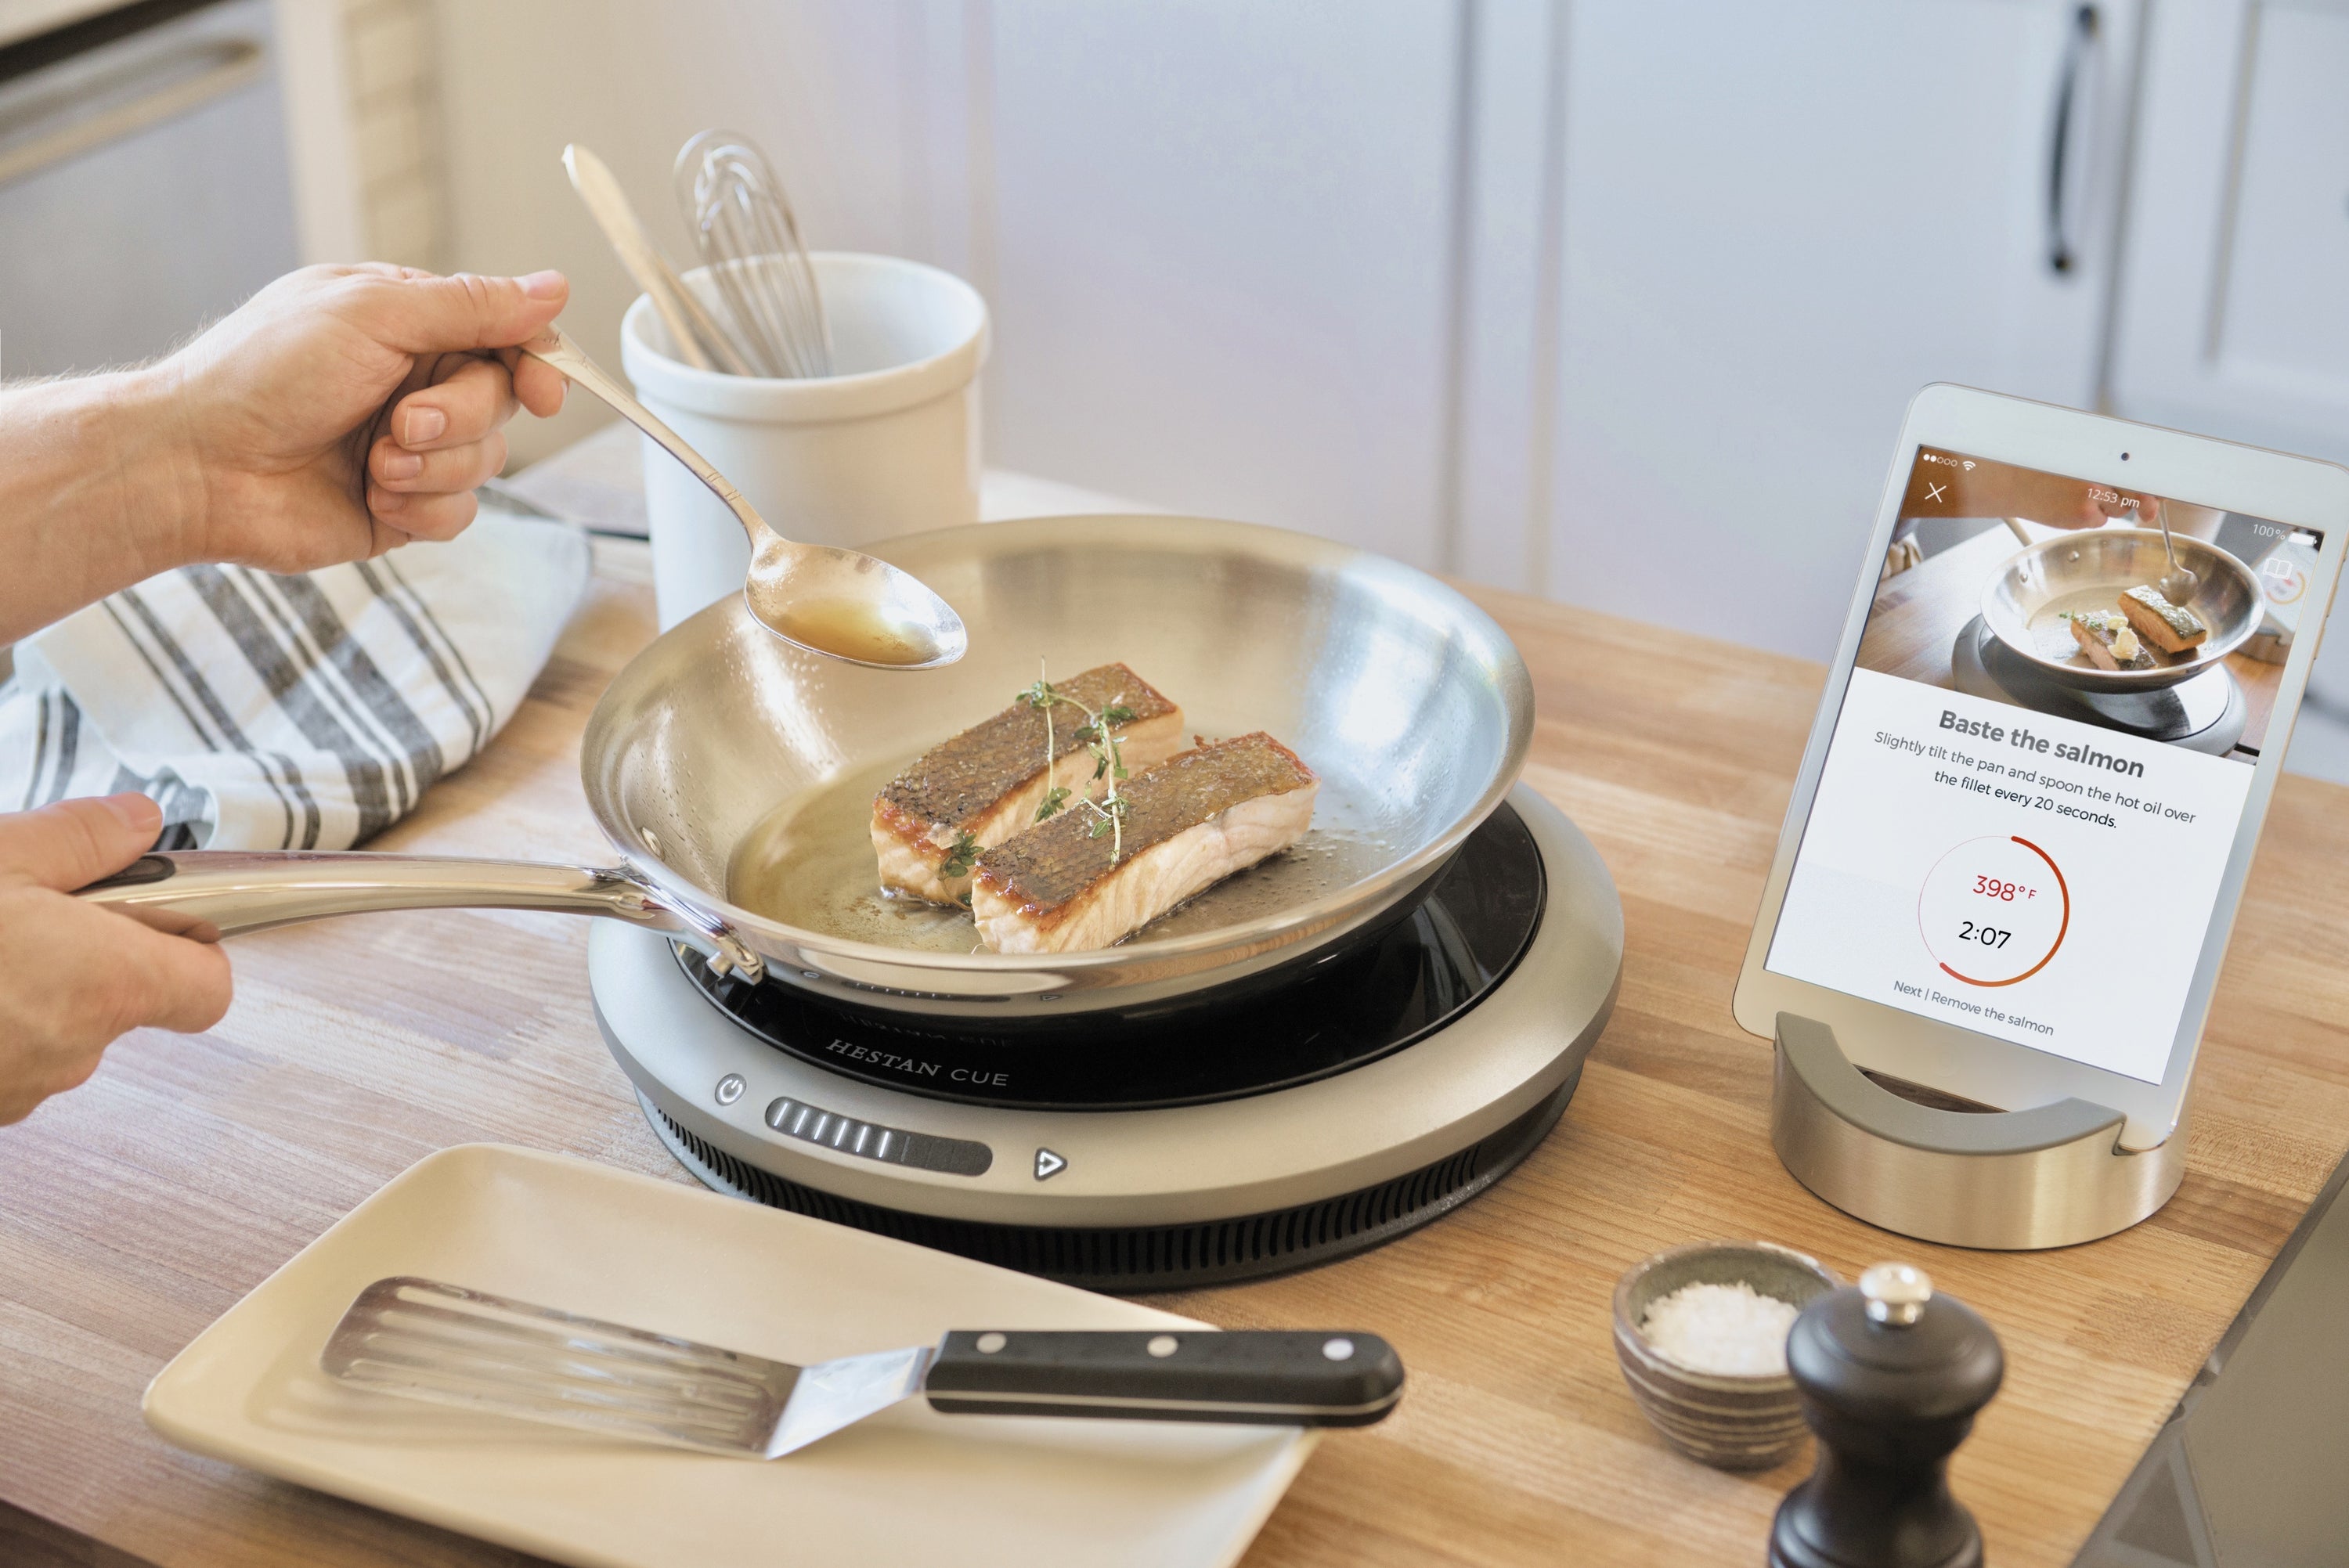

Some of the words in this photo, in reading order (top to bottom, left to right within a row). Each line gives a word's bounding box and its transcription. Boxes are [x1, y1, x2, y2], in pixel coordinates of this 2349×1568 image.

[2087, 487, 2118, 505] 12:53
[2120, 494, 2141, 510] pm
[2253, 523, 2286, 540] 100%
[1938, 709, 2005, 742] Baste
[2010, 729, 2050, 754] the
[2054, 742, 2145, 779] salmon
[1875, 731, 1925, 756] Slightly
[1928, 744, 1948, 760] tilt
[1950, 751, 1975, 767] the
[1976, 759, 2005, 775] pan
[2008, 767, 2037, 783] and
[2039, 776, 2084, 795] spoon
[2087, 785, 2112, 802] the
[2115, 793, 2140, 809] hot
[2142, 801, 2161, 815] oil
[2163, 809, 2196, 824] over
[1934, 770, 1958, 787] the
[1961, 777, 1992, 795] fillet
[1994, 787, 2033, 808] every
[2034, 796, 2054, 811] 20
[2056, 802, 2117, 829] seconds.
[1958, 921, 2012, 949] 2:07
[1893, 980, 1923, 998] Next
[1931, 991, 1982, 1015] Remove
[1984, 1007, 2005, 1022] the
[2008, 1016, 2055, 1036] salmon
[825, 1038, 942, 1077] HESTAN
[951, 1069, 1009, 1087] CUE
